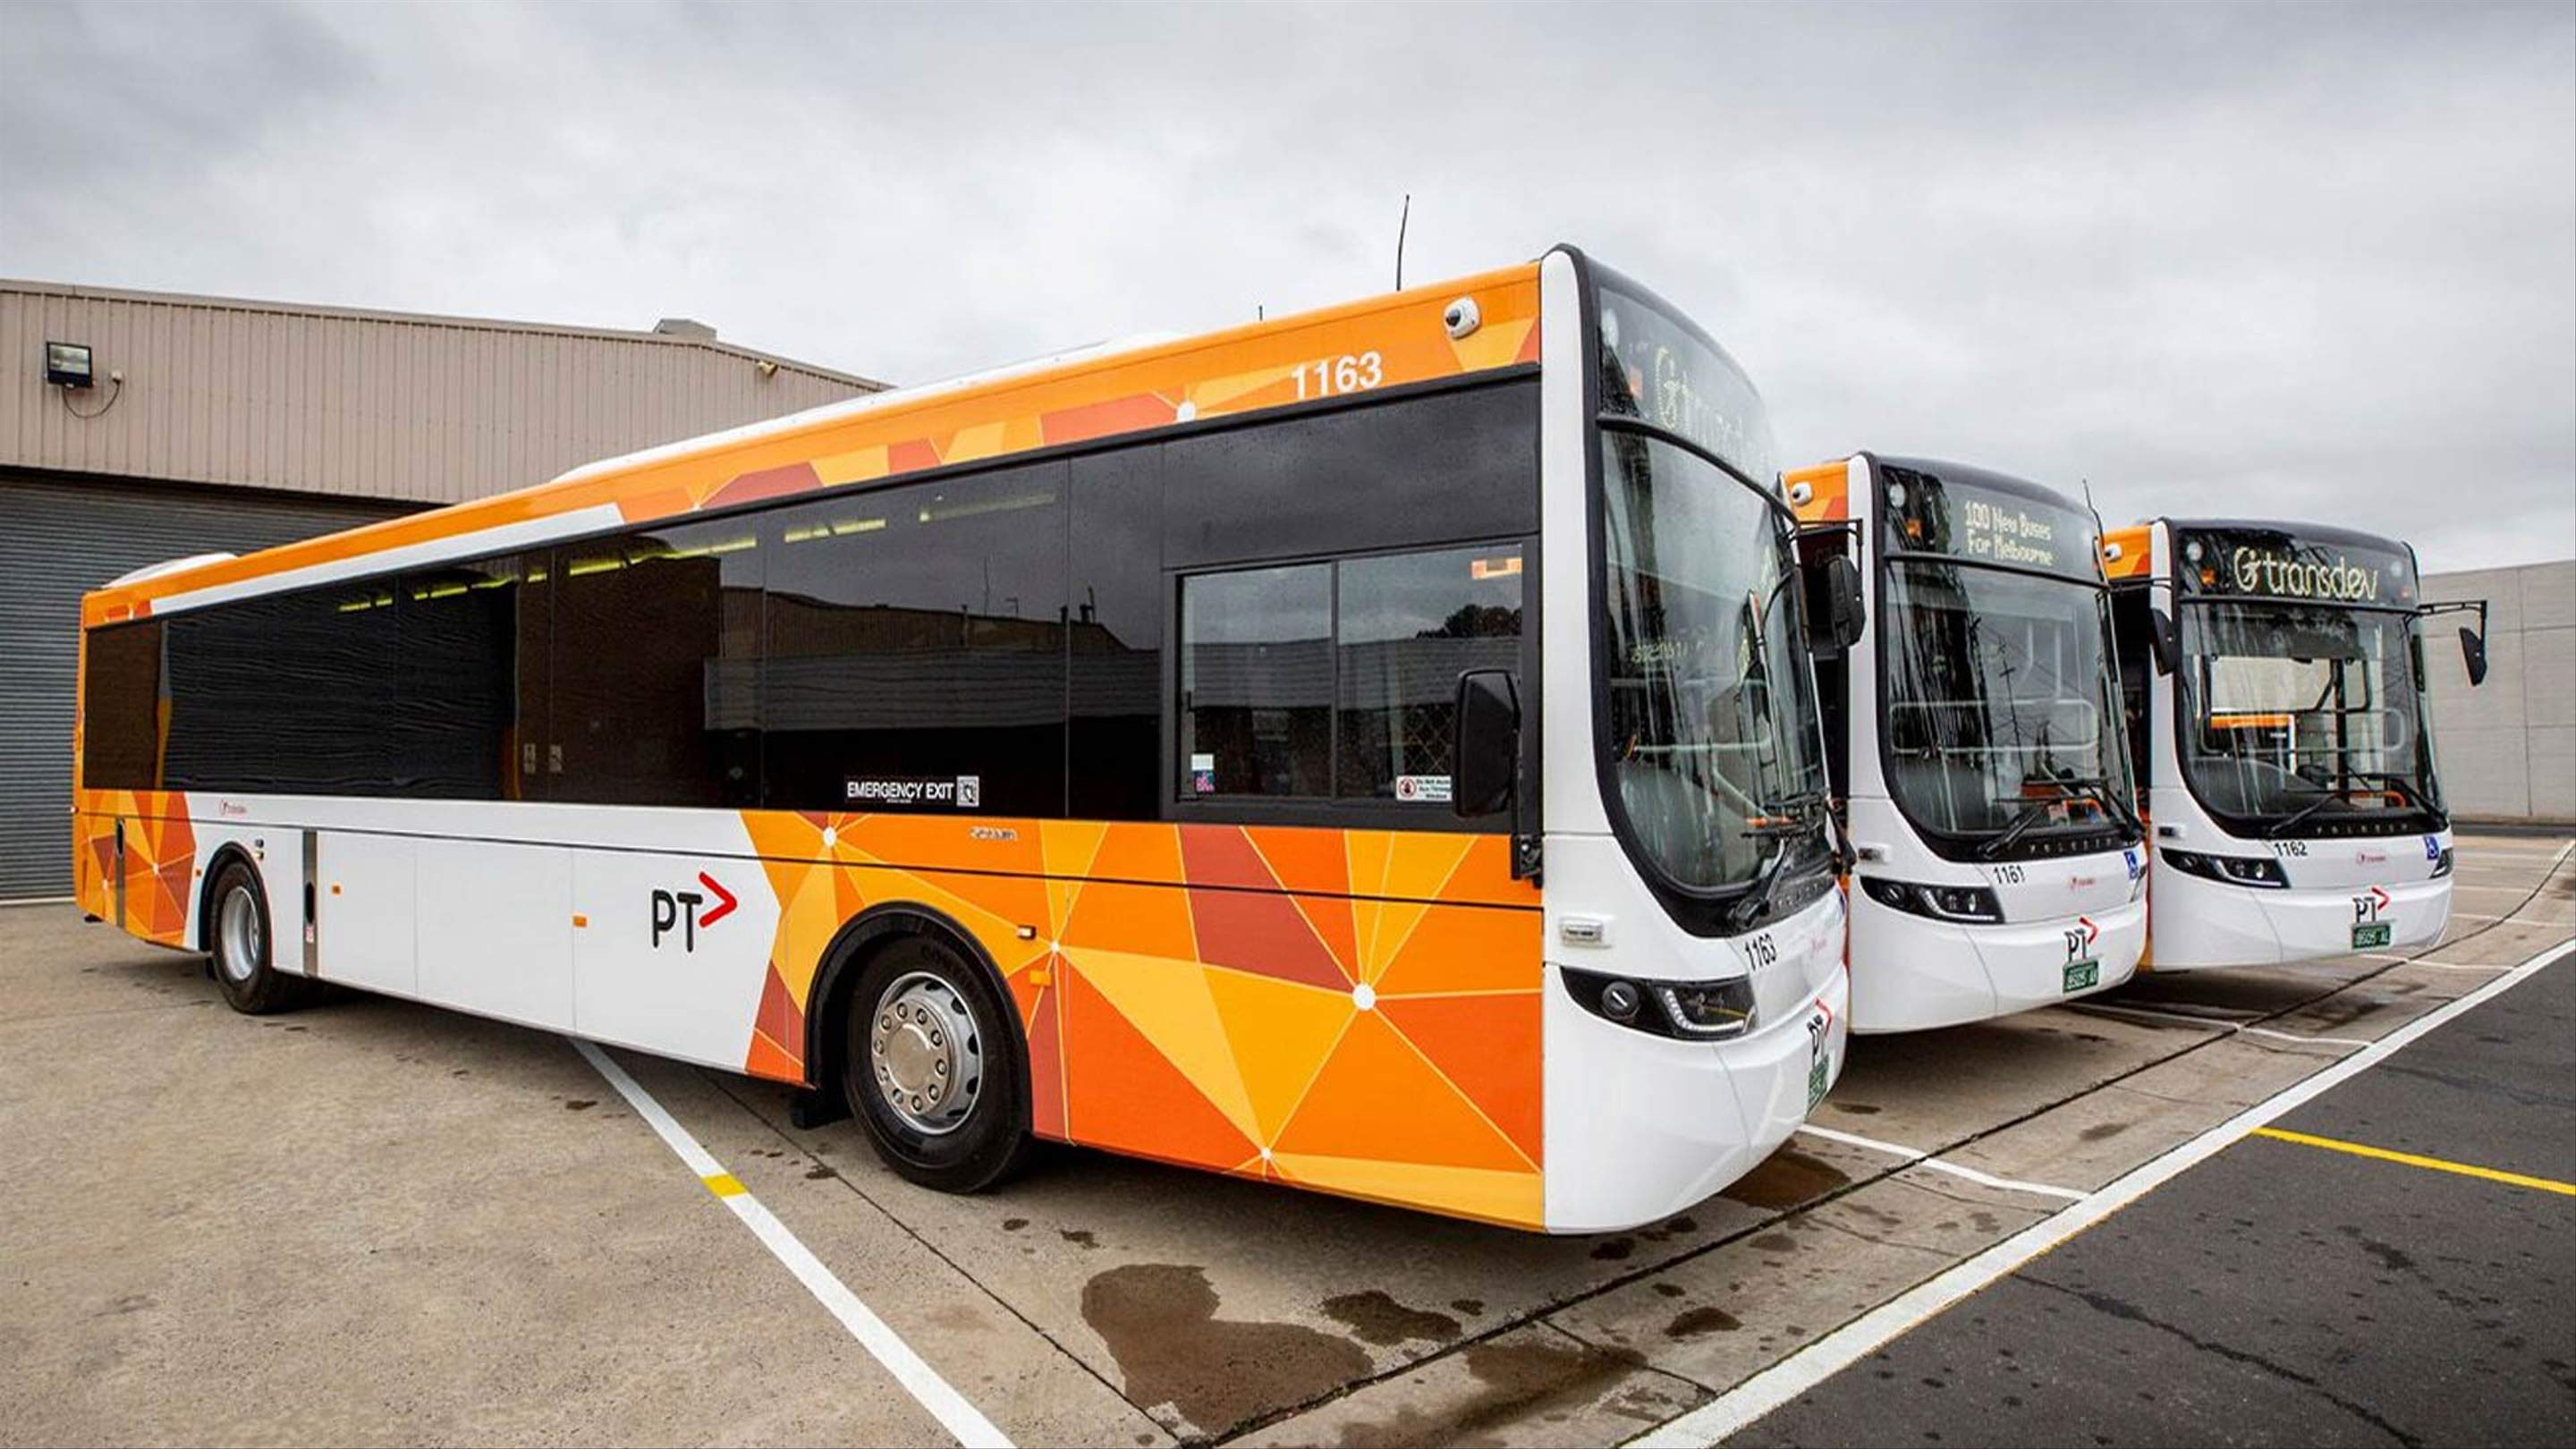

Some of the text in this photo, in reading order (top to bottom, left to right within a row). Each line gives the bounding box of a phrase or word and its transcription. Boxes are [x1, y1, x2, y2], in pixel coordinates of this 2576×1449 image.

[1291, 351, 1383, 402] 1163
[1965, 500, 2051, 541] 100 New Buses
[1967, 529, 2053, 567] For Melbourne
[2263, 551, 2378, 600] transdev
[847, 781, 954, 800] EMERGENCY EXIT
[2275, 841, 2308, 857] 1162
[1994, 864, 2025, 884] 1161
[651, 888, 704, 953] PT
[1745, 933, 1777, 971] 1163
